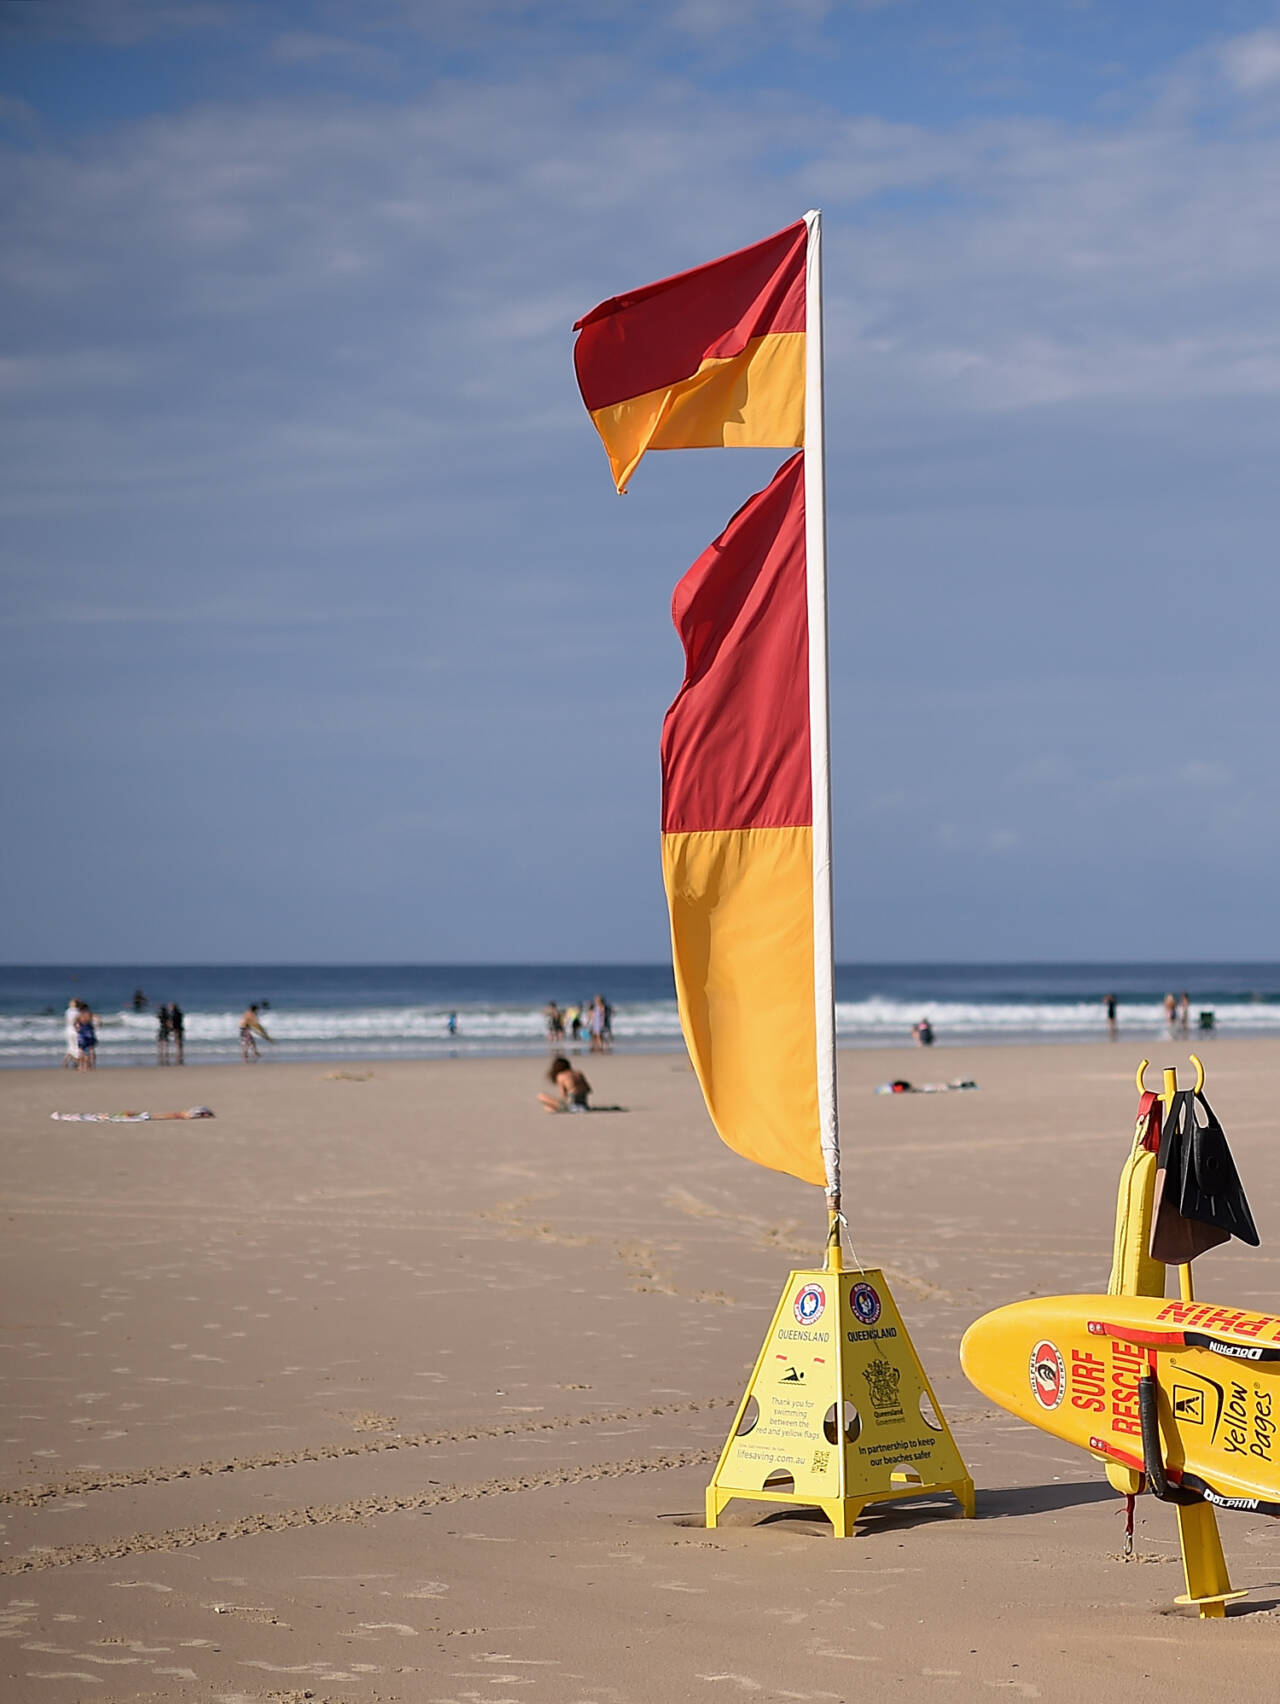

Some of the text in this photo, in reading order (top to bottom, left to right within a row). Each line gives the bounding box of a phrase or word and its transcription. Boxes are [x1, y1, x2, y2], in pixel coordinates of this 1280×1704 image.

[777, 1329, 830, 1342] QUEENSLAND
[847, 1327, 897, 1342] QUEENSLAND
[1208, 1340, 1263, 1360] DOLPHIN
[1071, 1348, 1106, 1413] SURF
[1111, 1341, 1146, 1437] RESCUE
[772, 1396, 790, 1405] Thank
[792, 1400, 804, 1408] you
[773, 1408, 807, 1418] swimming
[1223, 1381, 1248, 1456] Yellow
[769, 1418, 809, 1428] between the
[1250, 1390, 1277, 1462] Pages
[768, 1428, 780, 1436] and
[781, 1429, 803, 1438] yellow
[804, 1430, 820, 1440] flags
[858, 1437, 936, 1455] In partnership to keep
[737, 1449, 806, 1465] lifesaving.com.au
[870, 1450, 931, 1467] our beaches safer
[1203, 1488, 1260, 1509] DOLPHIN
